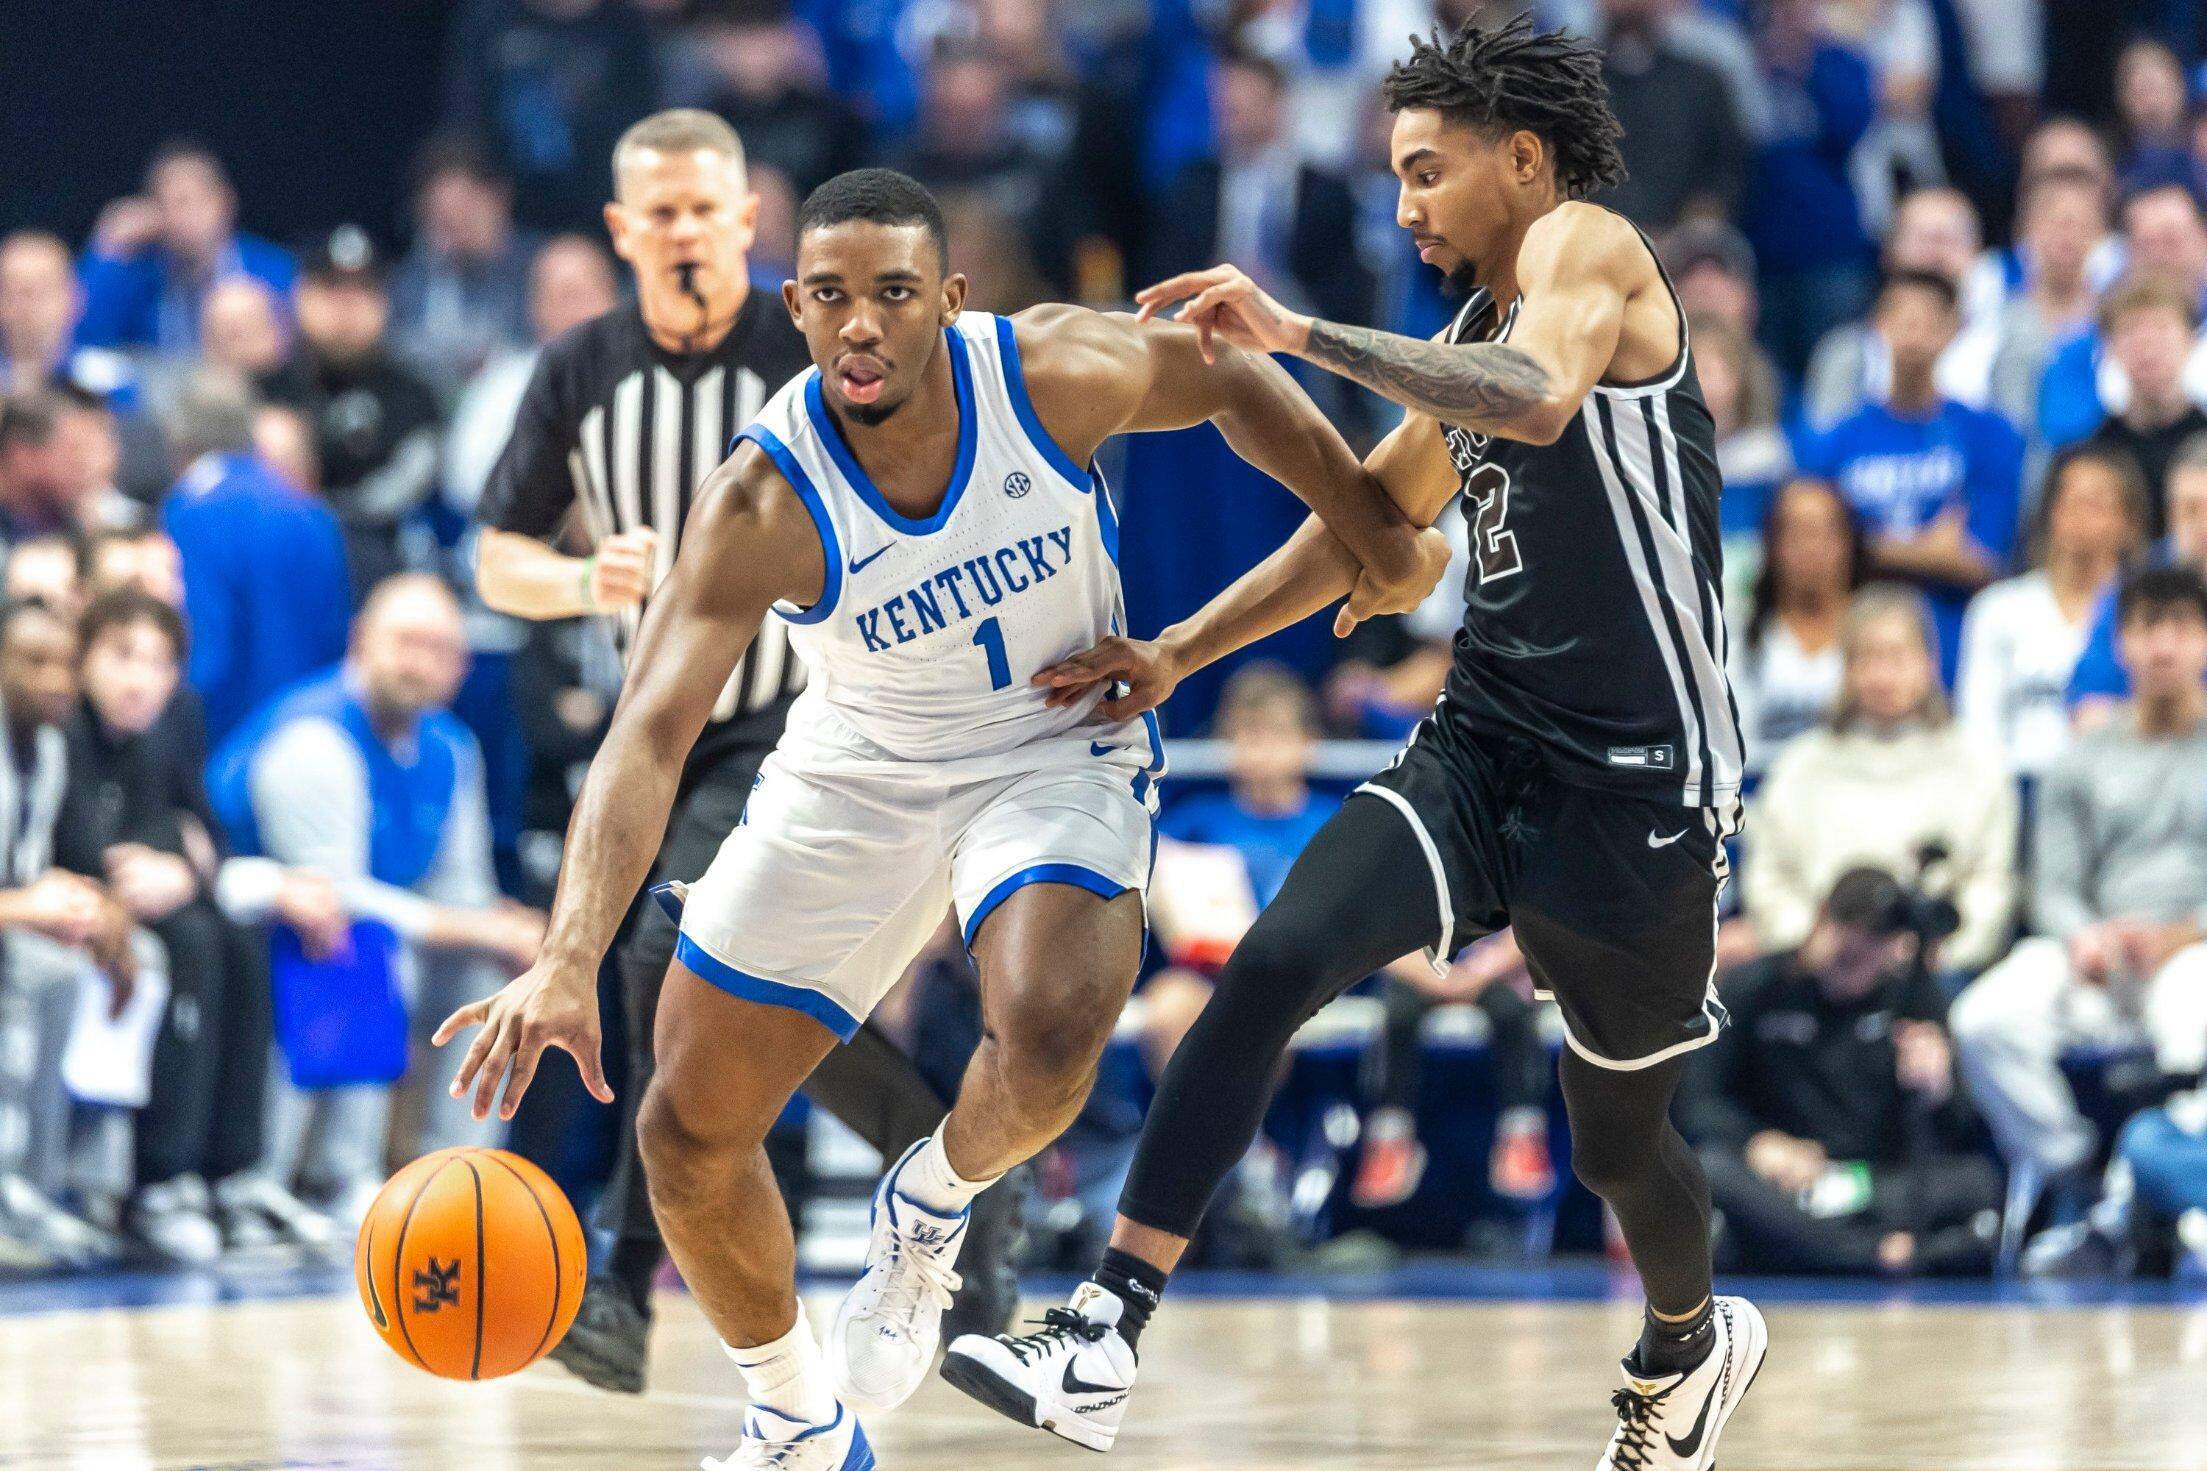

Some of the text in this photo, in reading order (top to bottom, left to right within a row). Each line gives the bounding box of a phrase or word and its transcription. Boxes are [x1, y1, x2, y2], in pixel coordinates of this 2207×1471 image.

[1004, 472, 1031, 498] SEC
[1464, 462, 1523, 585] 2
[856, 525, 1072, 653] KENTUCKY
[972, 615, 1013, 692] 1
[1654, 749, 1665, 762] S
[412, 1255, 462, 1316] UK
